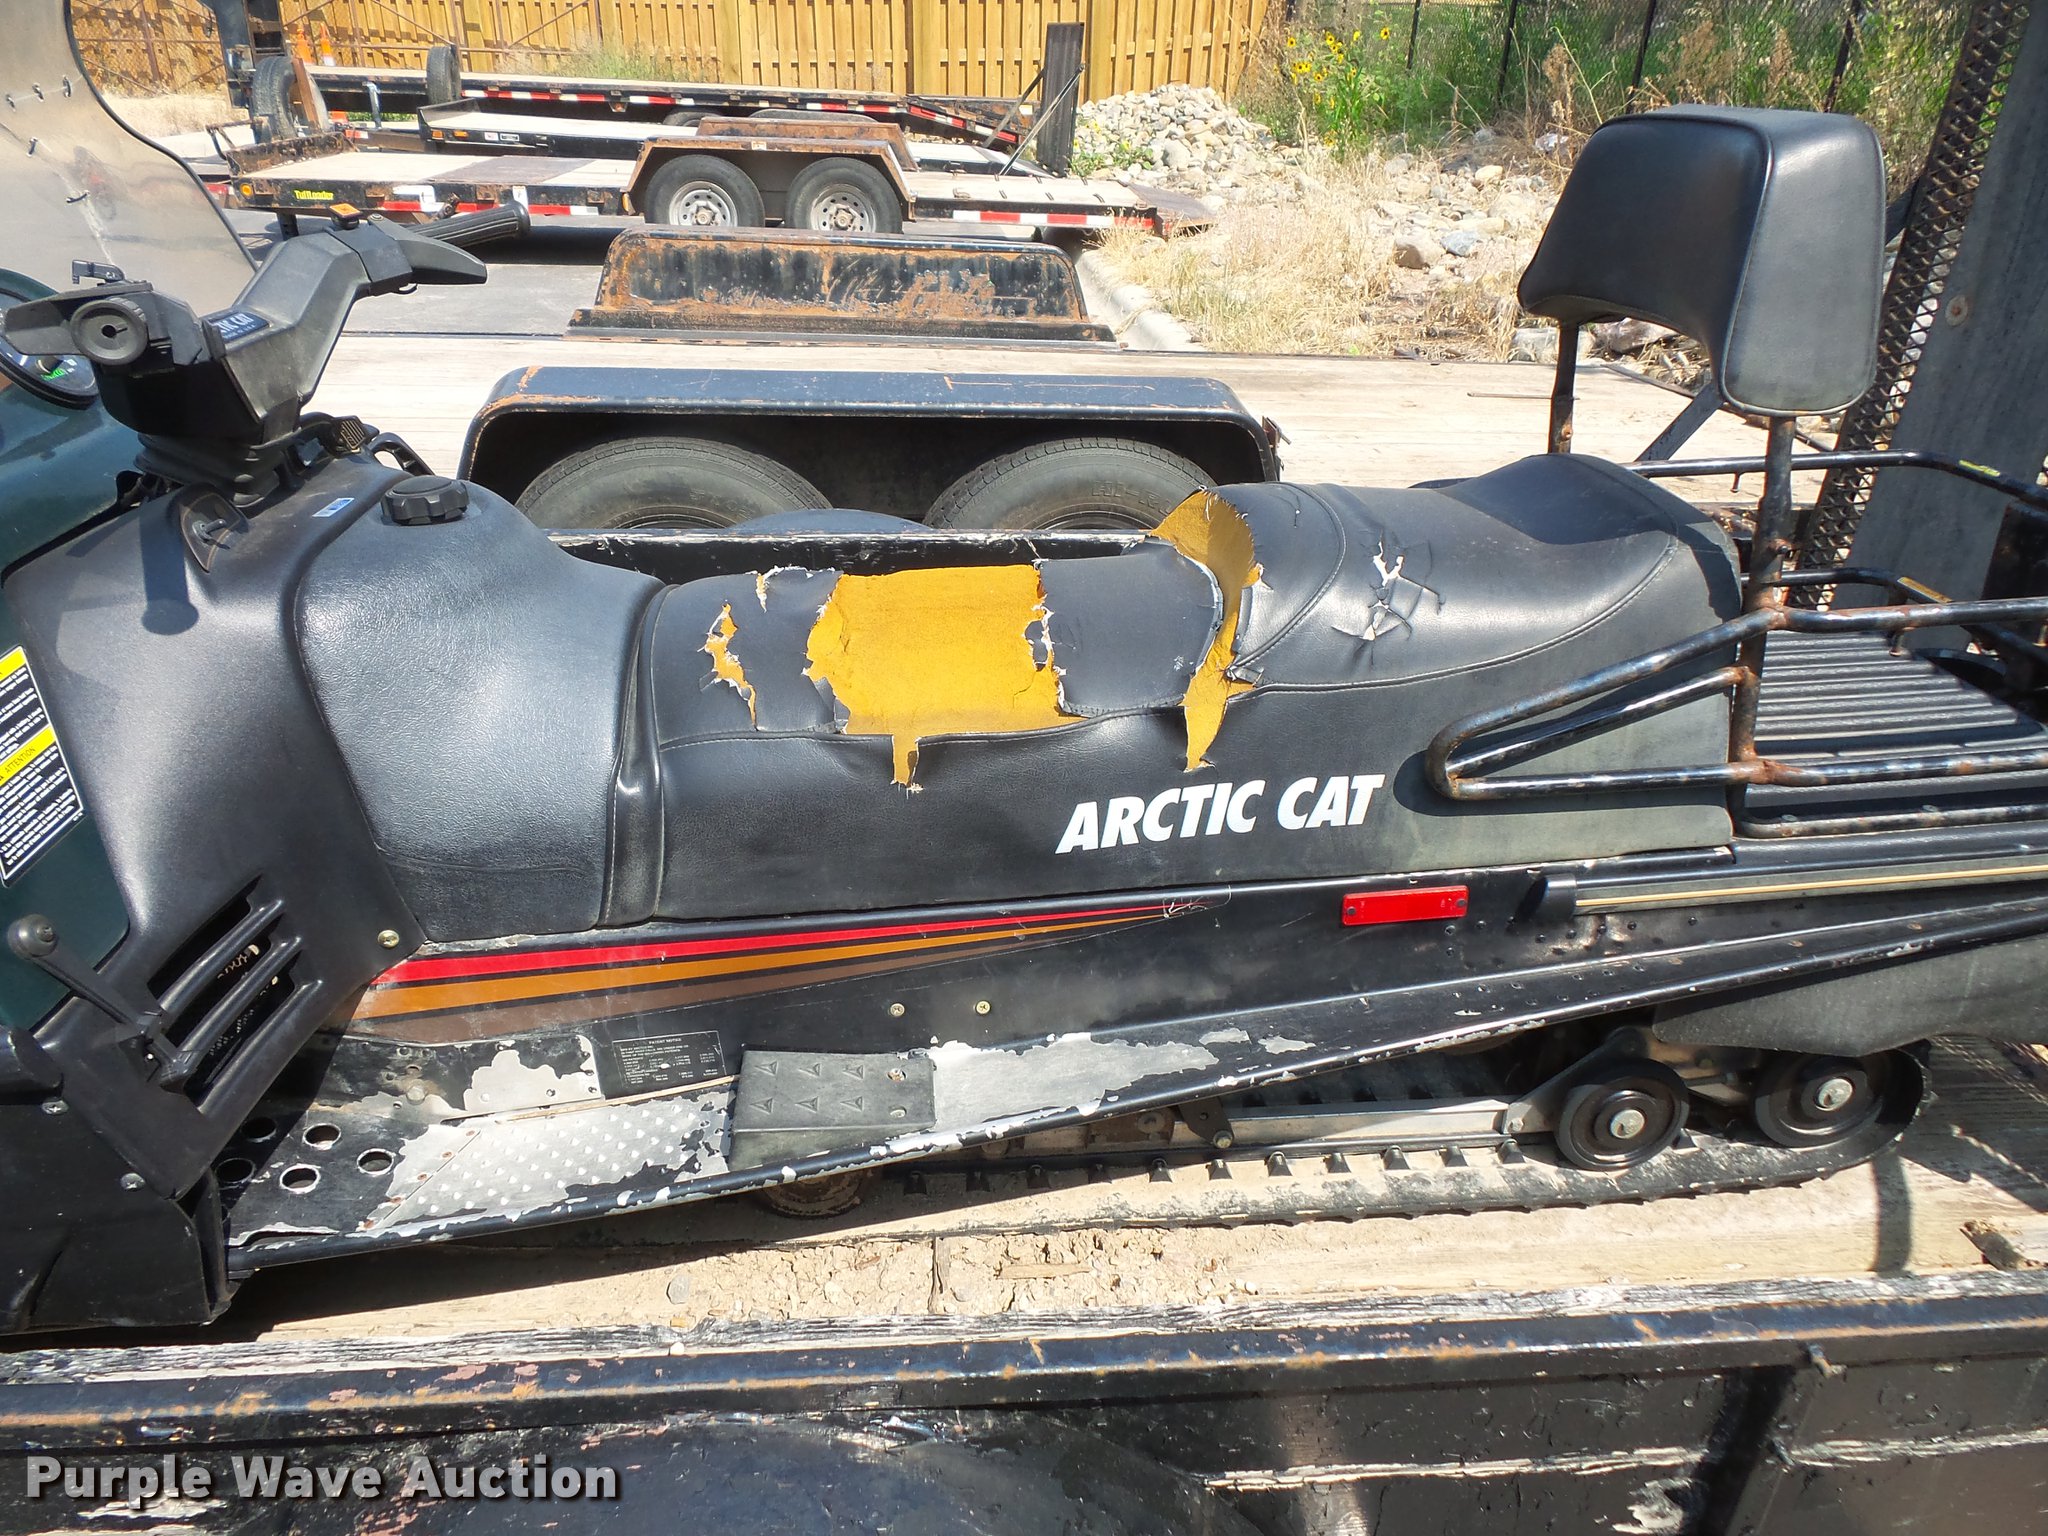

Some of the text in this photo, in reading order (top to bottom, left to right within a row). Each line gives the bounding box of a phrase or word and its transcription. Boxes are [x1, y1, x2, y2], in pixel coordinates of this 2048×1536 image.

[4, 747, 36, 773] ATTENTION
[1055, 774, 1385, 854] ARCTIC CAT
